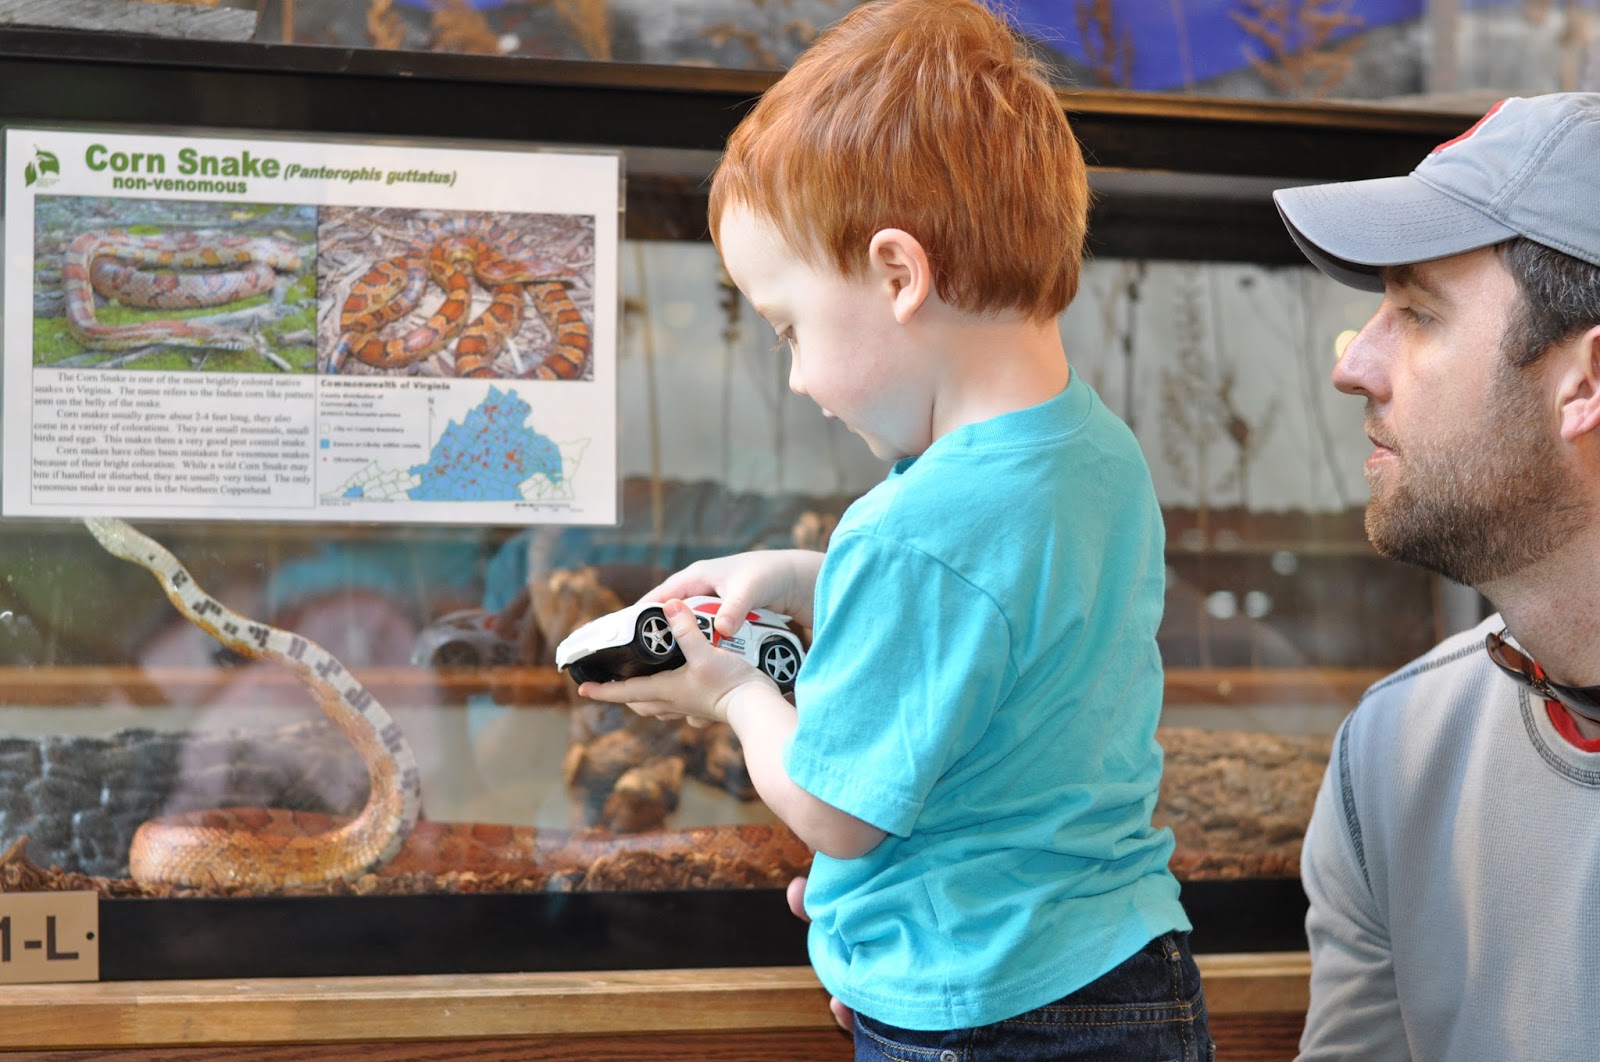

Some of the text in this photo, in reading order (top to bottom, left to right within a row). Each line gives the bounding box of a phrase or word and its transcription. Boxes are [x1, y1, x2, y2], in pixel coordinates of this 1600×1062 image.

[85, 144, 457, 187] Corn Snake (Panterophis guttatus)
[113, 176, 247, 194] non-venomous
[58, 373, 74, 382] The
[77, 373, 98, 382] Corn
[101, 374, 126, 383] Snake
[129, 374, 136, 383] is
[157, 374, 166, 383] of
[168, 375, 180, 383] the
[183, 376, 203, 384] most
[206, 376, 239, 386] brightly
[320, 380, 451, 390] Commonwealth of Virginia
[34, 384, 63, 393] snakes
[66, 385, 74, 393] in
[119, 386, 136, 395] The
[163, 387, 186, 396] refers
[189, 388, 198, 397] to
[200, 388, 213, 397] the
[216, 388, 242, 397] Indian
[245, 390, 264, 398] corn
[266, 389, 281, 398] like
[69, 398, 82, 406] the
[85, 398, 106, 409] belly
[108, 398, 118, 407] of
[120, 399, 133, 407] the
[57, 409, 78, 418] Corn
[81, 410, 109, 419] snakes
[112, 410, 143, 421] usually
[144, 413, 166, 421] grow
[169, 412, 192, 420] about
[195, 412, 209, 420] 2-4
[212, 412, 227, 420] feet
[254, 414, 272, 424] they
[274, 414, 292, 422] also
[60, 422, 69, 430] in
[80, 423, 108, 433] variety
[110, 423, 120, 432] of
[177, 424, 198, 434] They
[215, 424, 238, 433] small
[286, 425, 309, 434] small
[34, 434, 56, 443] birds
[58, 435, 74, 443] and
[104, 434, 123, 443] This
[125, 435, 153, 444] makes
[155, 435, 176, 444] them
[186, 439, 204, 447] very
[206, 438, 228, 447] good
[230, 439, 247, 448] pest
[56, 446, 78, 455] Corn
[81, 447, 109, 455] snakes
[112, 447, 132, 456] have
[134, 447, 156, 456] often
[158, 448, 178, 457] been
[181, 449, 219, 457] mistaken
[221, 449, 233, 457] for
[282, 450, 310, 458] snakes
[34, 459, 67, 467] because
[70, 459, 79, 467] of
[82, 459, 101, 467] their
[104, 460, 129, 470] bright
[182, 460, 208, 469] While
[218, 461, 237, 469] wild
[239, 462, 260, 470] Corn
[262, 462, 288, 471] Snake
[290, 464, 308, 472] may
[34, 471, 49, 479] bite
[52, 471, 60, 479] if
[61, 471, 95, 479] handled
[154, 472, 172, 482] they
[190, 473, 220, 483] usually
[222, 475, 241, 483] very
[274, 474, 291, 482] The
[292, 475, 311, 485] only
[80, 484, 104, 492] snake
[107, 484, 115, 492] in
[164, 485, 178, 493] the
[180, 485, 218, 494] Northern
